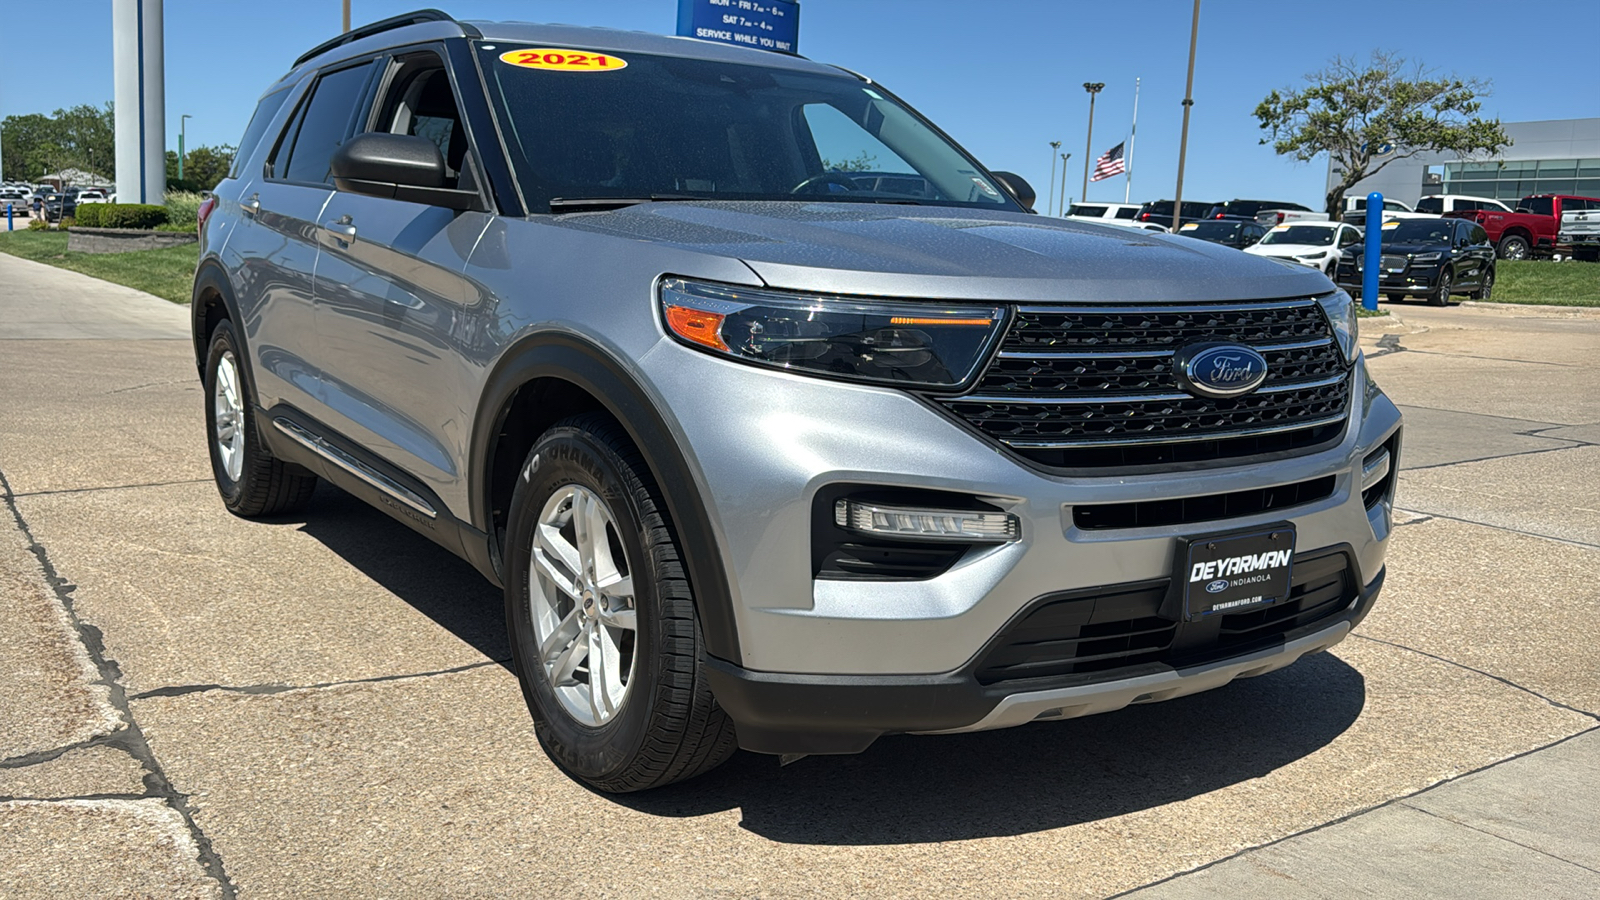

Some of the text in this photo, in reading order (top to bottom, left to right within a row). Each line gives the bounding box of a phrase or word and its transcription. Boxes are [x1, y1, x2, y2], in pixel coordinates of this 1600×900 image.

[739, 1, 752, 10] FRI
[722, 14, 738, 25] SAT
[696, 27, 791, 51] SERVICE WHILE YOU WAIT
[518, 52, 608, 67] 2021
[1210, 355, 1252, 383] Ford
[1189, 549, 1292, 583] DEYARMAN
[1230, 573, 1271, 587] INDIANOLA
